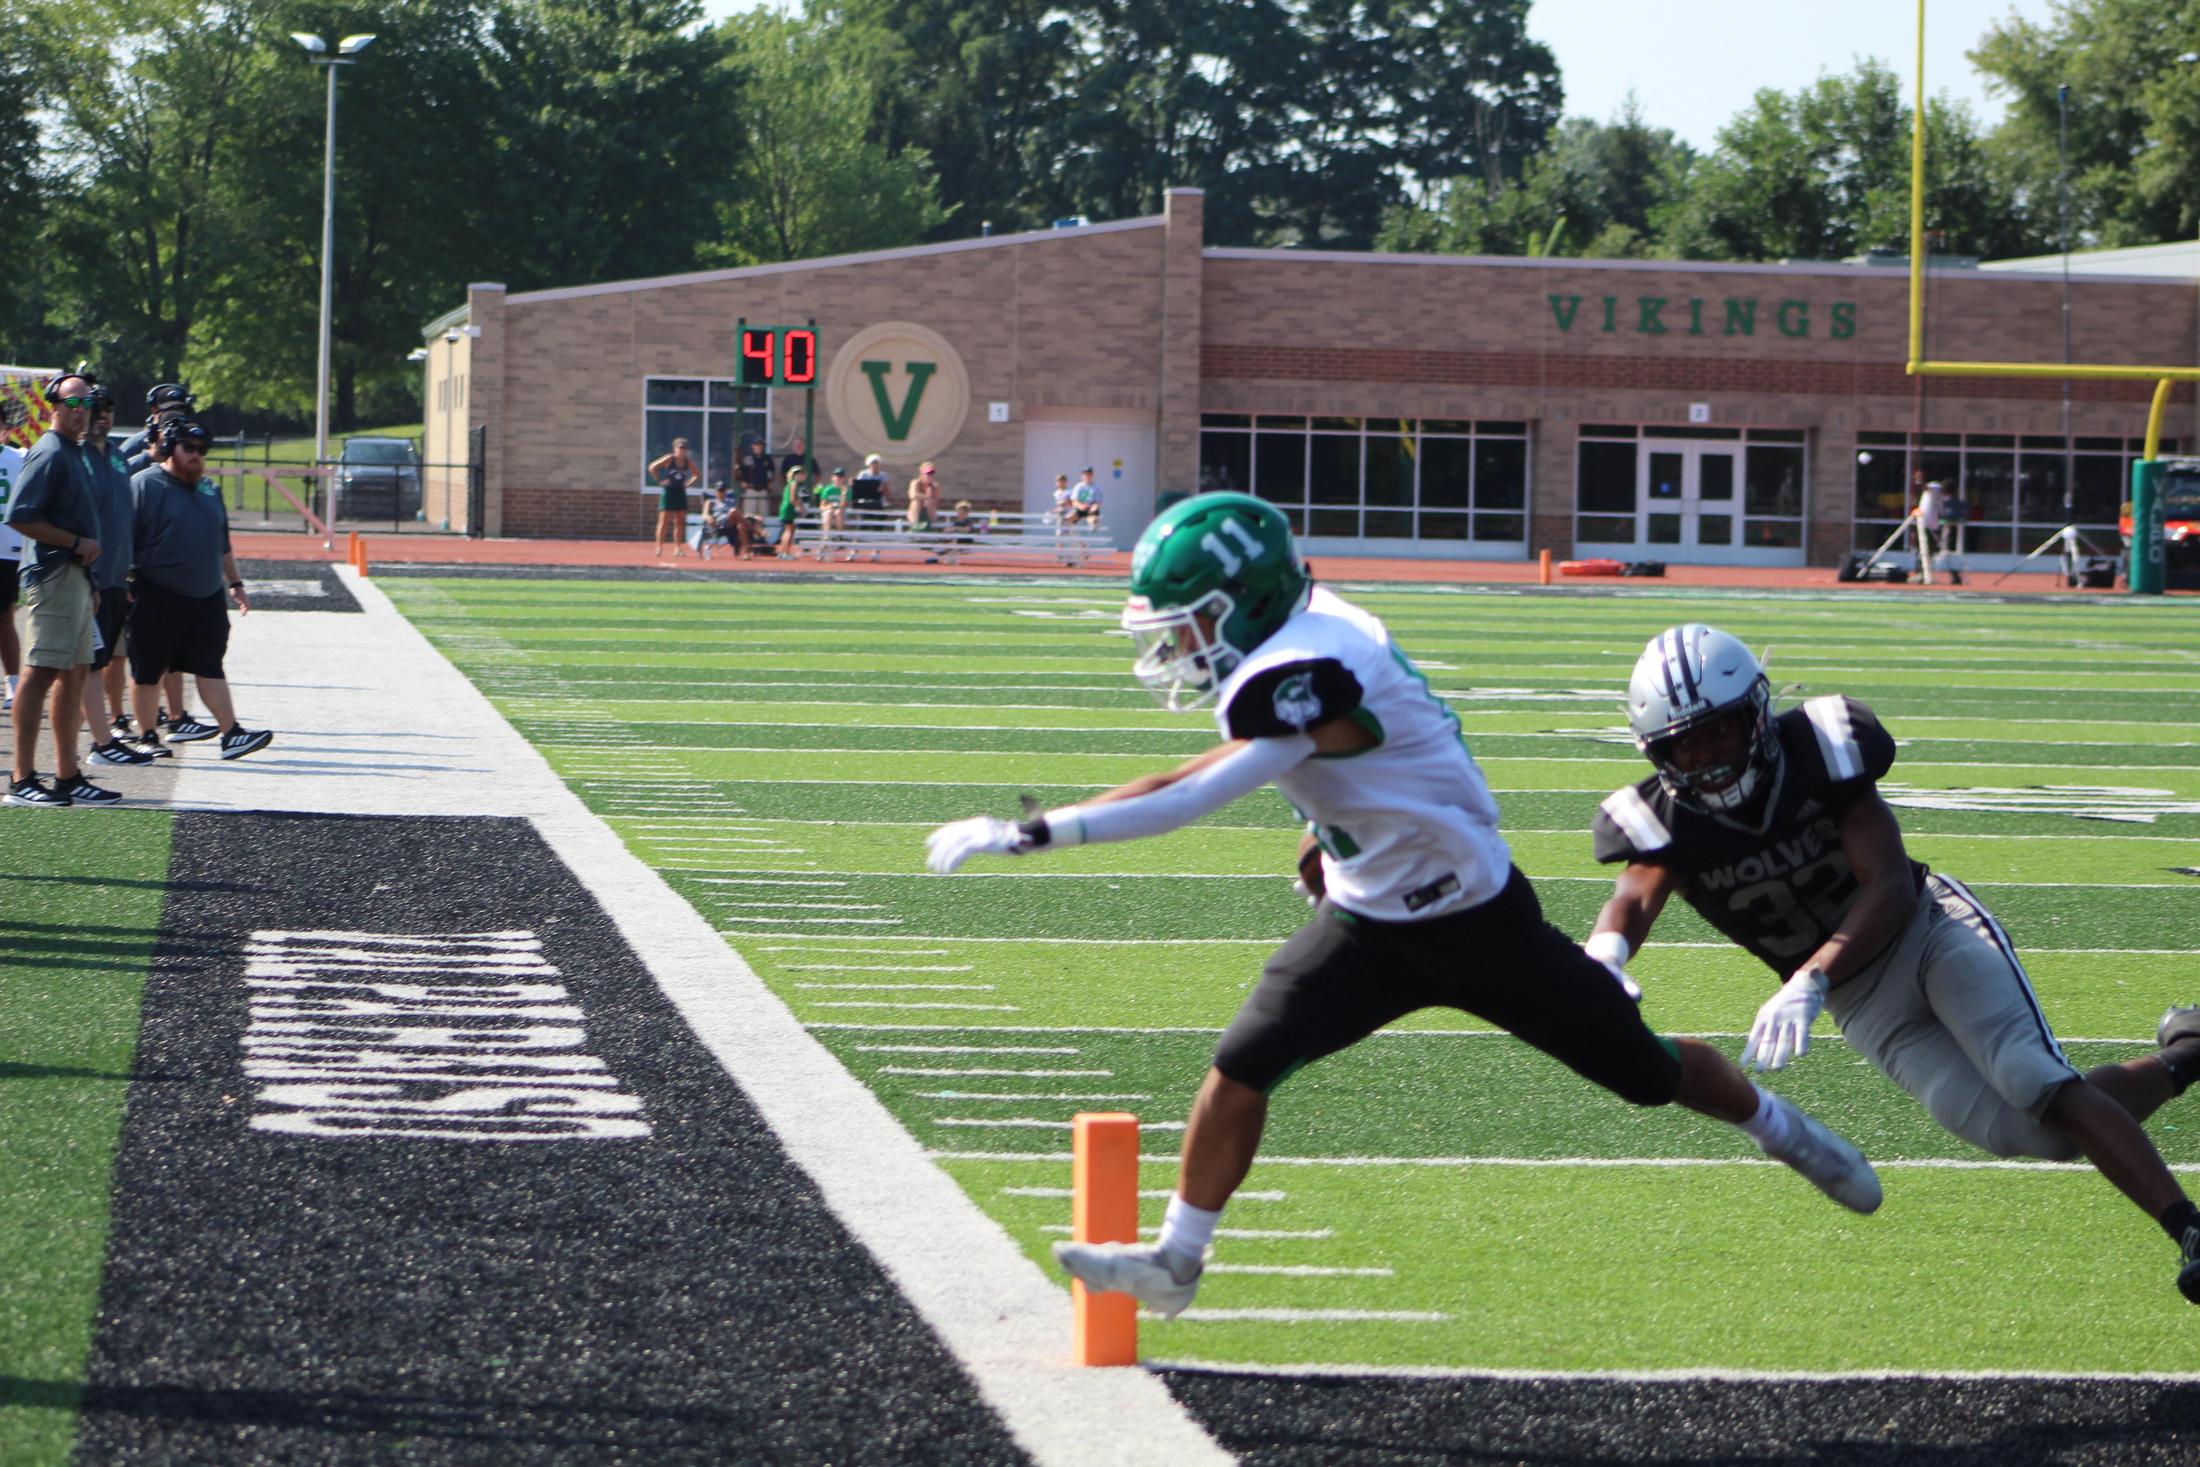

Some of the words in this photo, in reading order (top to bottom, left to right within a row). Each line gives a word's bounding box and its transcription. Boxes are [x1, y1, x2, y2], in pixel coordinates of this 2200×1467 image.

[1547, 294, 1857, 340] VIKINGS
[743, 330, 815, 382] 40
[860, 360, 937, 440] V
[1201, 517, 1265, 577] 11
[2149, 477, 2164, 563] VALPO
[1700, 818, 1841, 890] WOLVES
[241, 929, 652, 1138] VALPARAISO
